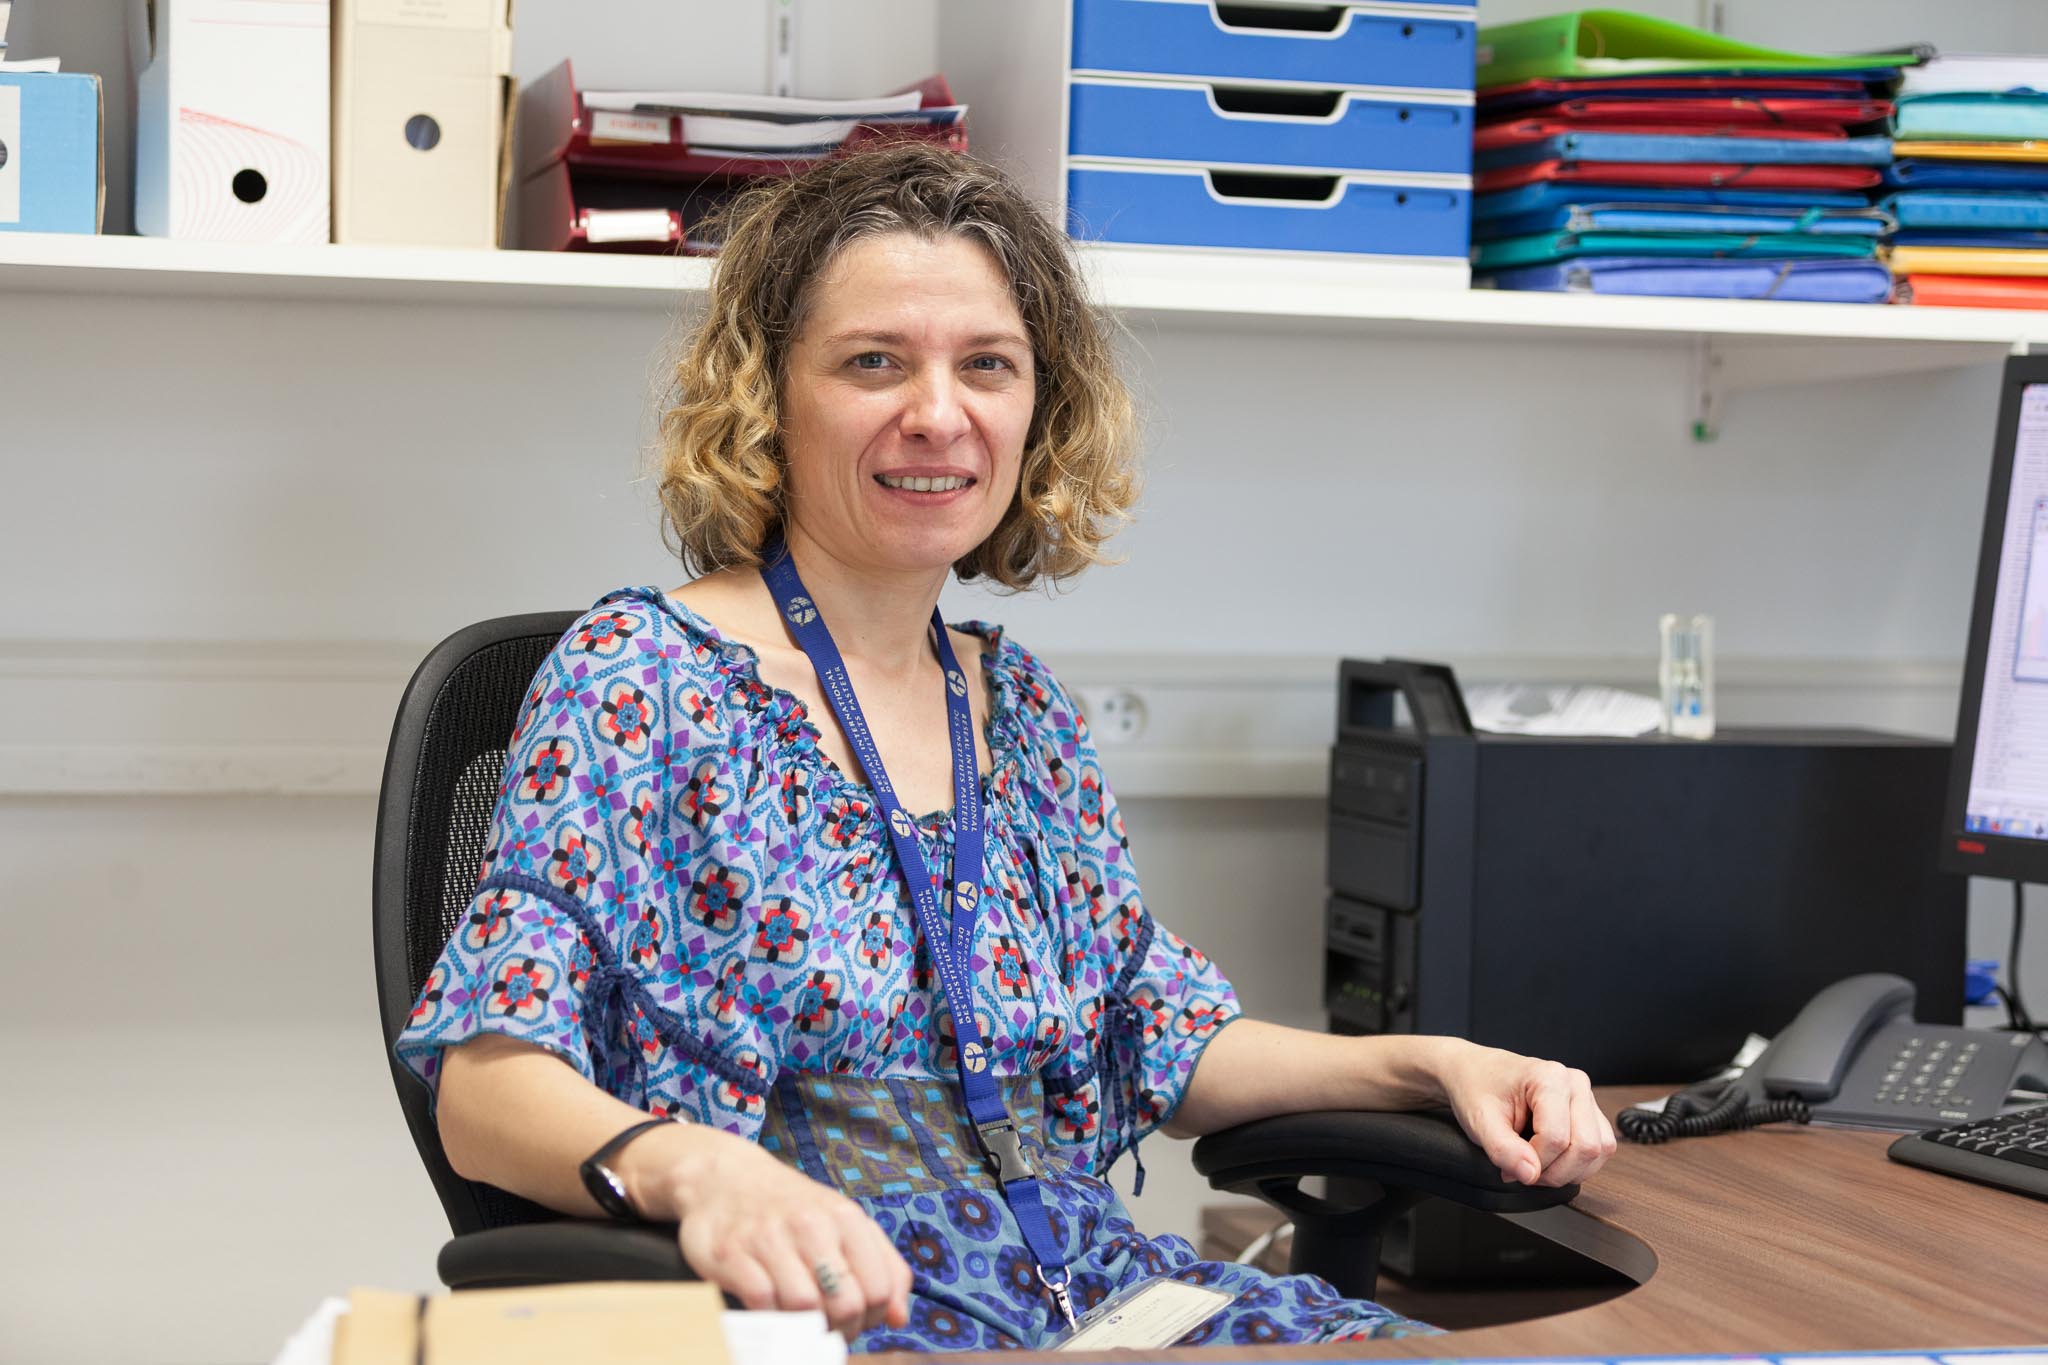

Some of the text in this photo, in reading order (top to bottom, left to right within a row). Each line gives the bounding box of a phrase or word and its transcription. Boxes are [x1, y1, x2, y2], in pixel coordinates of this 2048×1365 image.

[825, 668, 866, 751] INTERNATIONAL
[833, 665, 893, 793] DES INSTITUTS PASTEUR
[955, 730, 966, 783] INSTITUTS
[965, 753, 978, 832] INTERNATIONAL
[960, 786, 969, 831] PASTEUR
[917, 891, 949, 979] INTERNATIONAL
[924, 888, 972, 1024] DES INSTITUTS PASTEUR
[957, 926, 965, 946] DES
